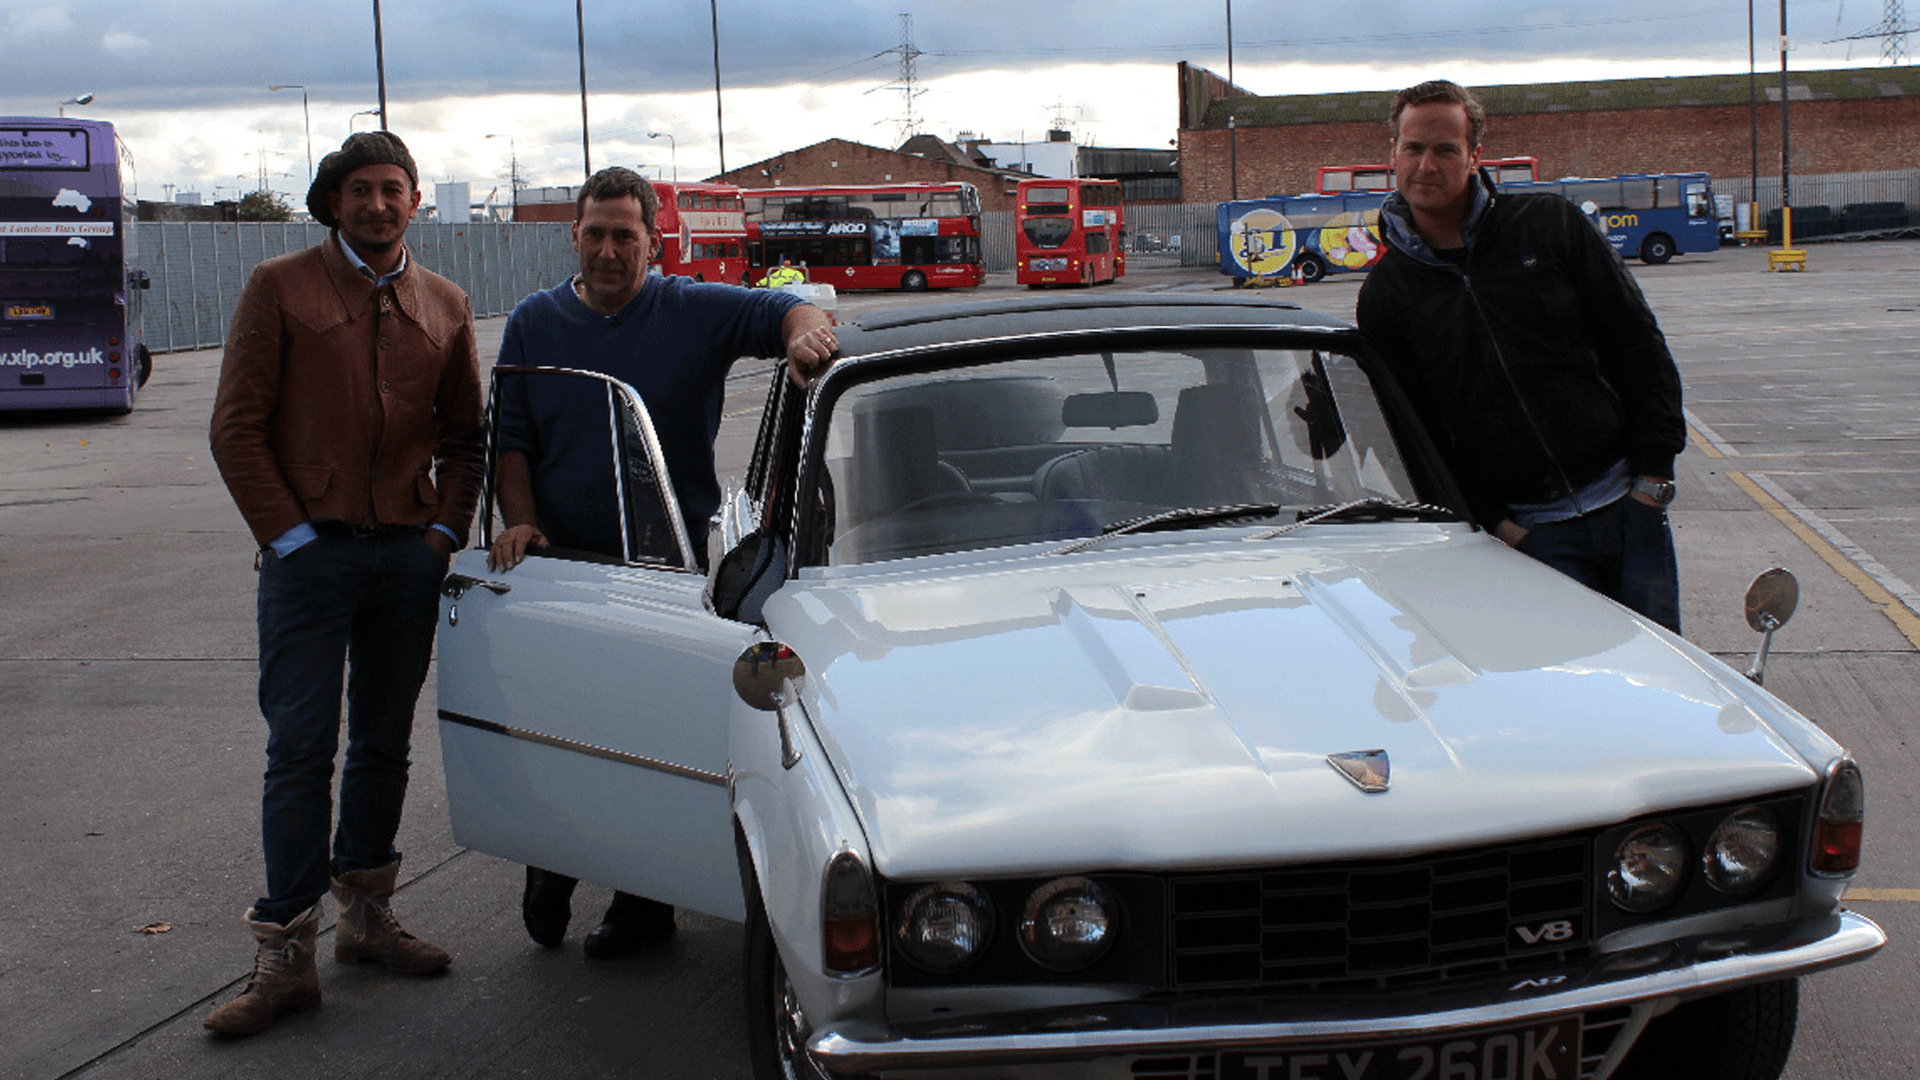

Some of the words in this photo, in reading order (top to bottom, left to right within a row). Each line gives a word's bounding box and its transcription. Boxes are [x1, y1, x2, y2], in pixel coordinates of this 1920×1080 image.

[10, 224, 51, 234] London
[55, 224, 75, 234] Bus
[826, 222, 867, 236] ARGO
[1513, 920, 1575, 945] V8
[1396, 1026, 1559, 1080] 260K
